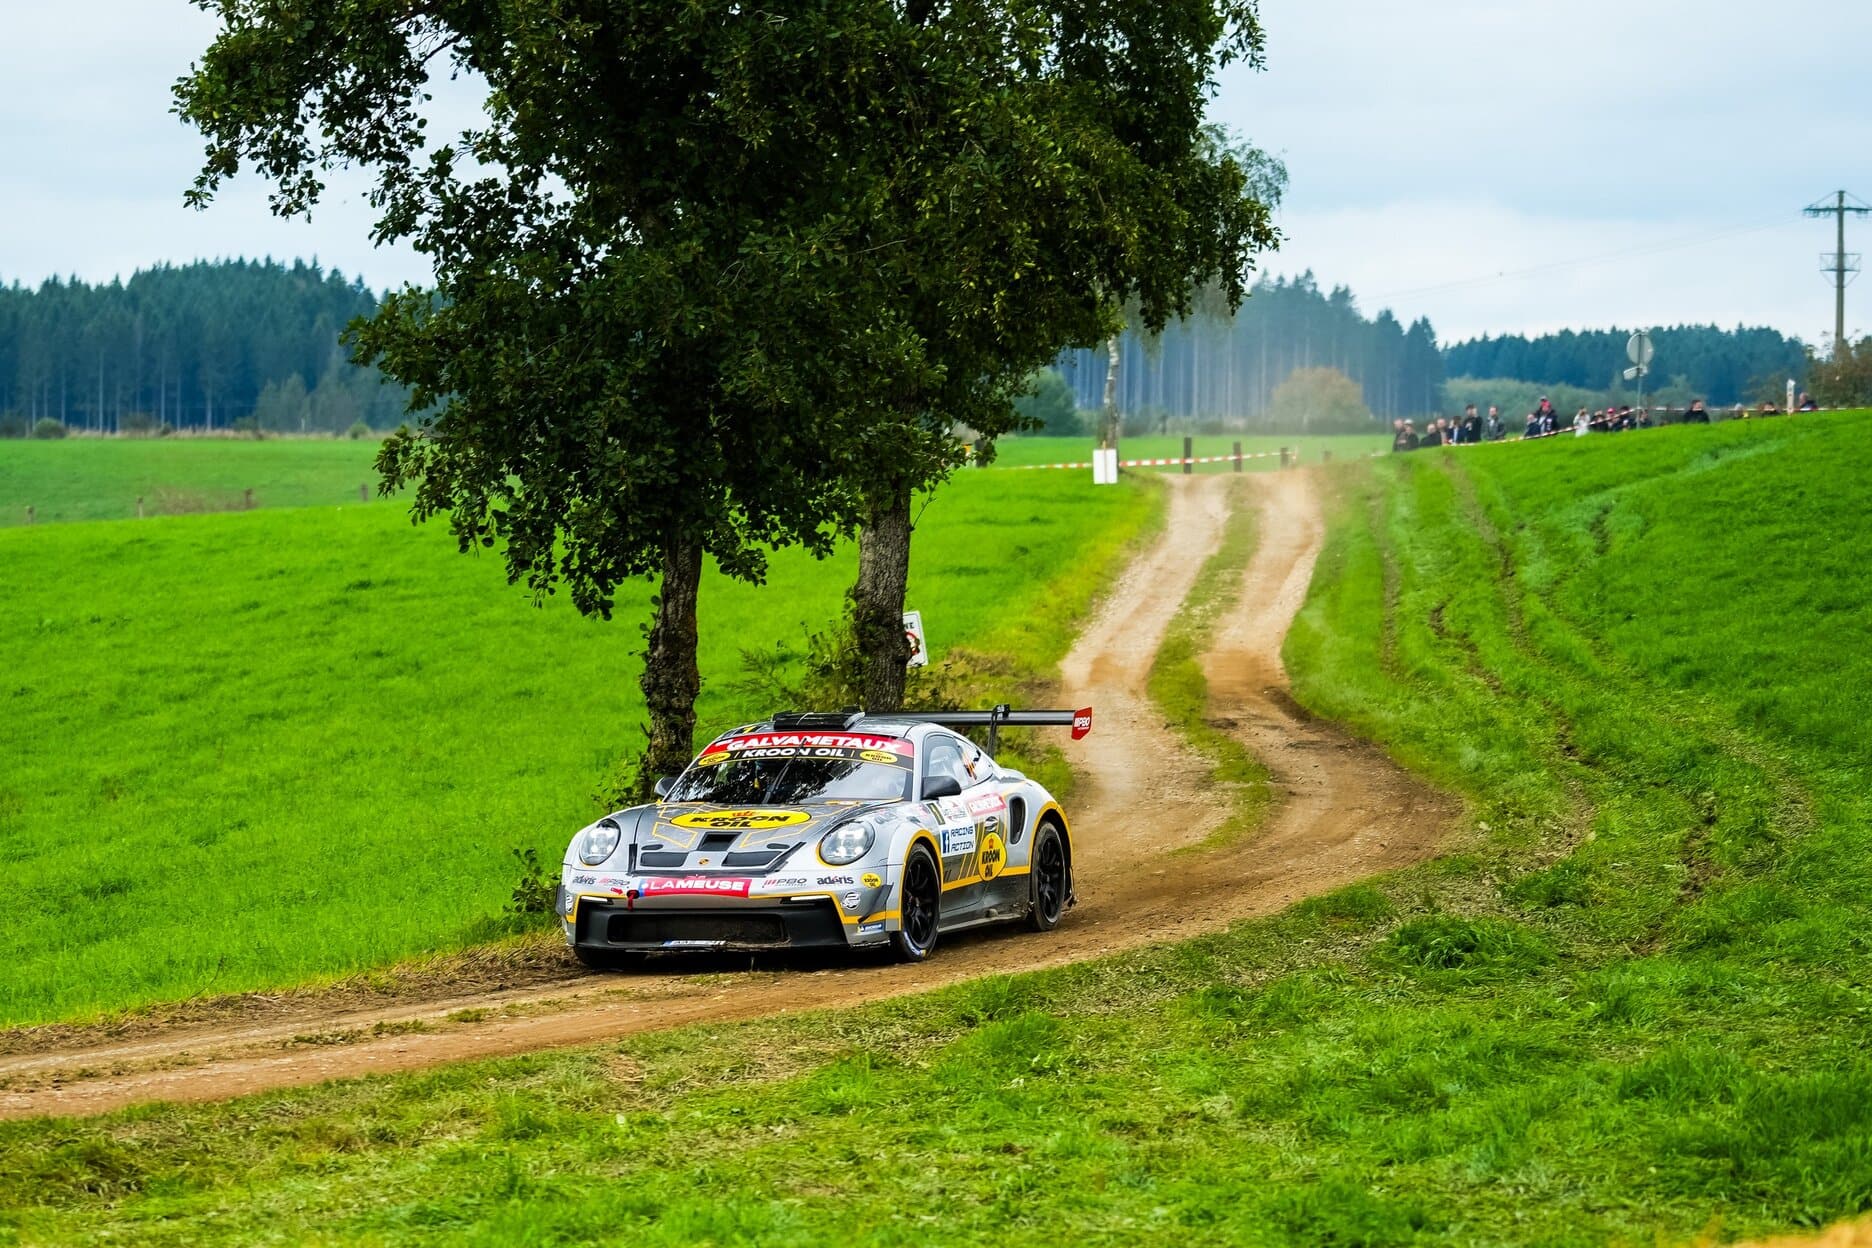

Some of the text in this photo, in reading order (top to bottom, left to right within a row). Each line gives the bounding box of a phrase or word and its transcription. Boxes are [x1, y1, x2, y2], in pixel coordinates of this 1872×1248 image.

[727, 735, 903, 753] GALVAMETAUX
[742, 748, 845, 758] KROON OIL
[690, 815, 790, 823] KROON
[951, 841, 974, 852] ACTION
